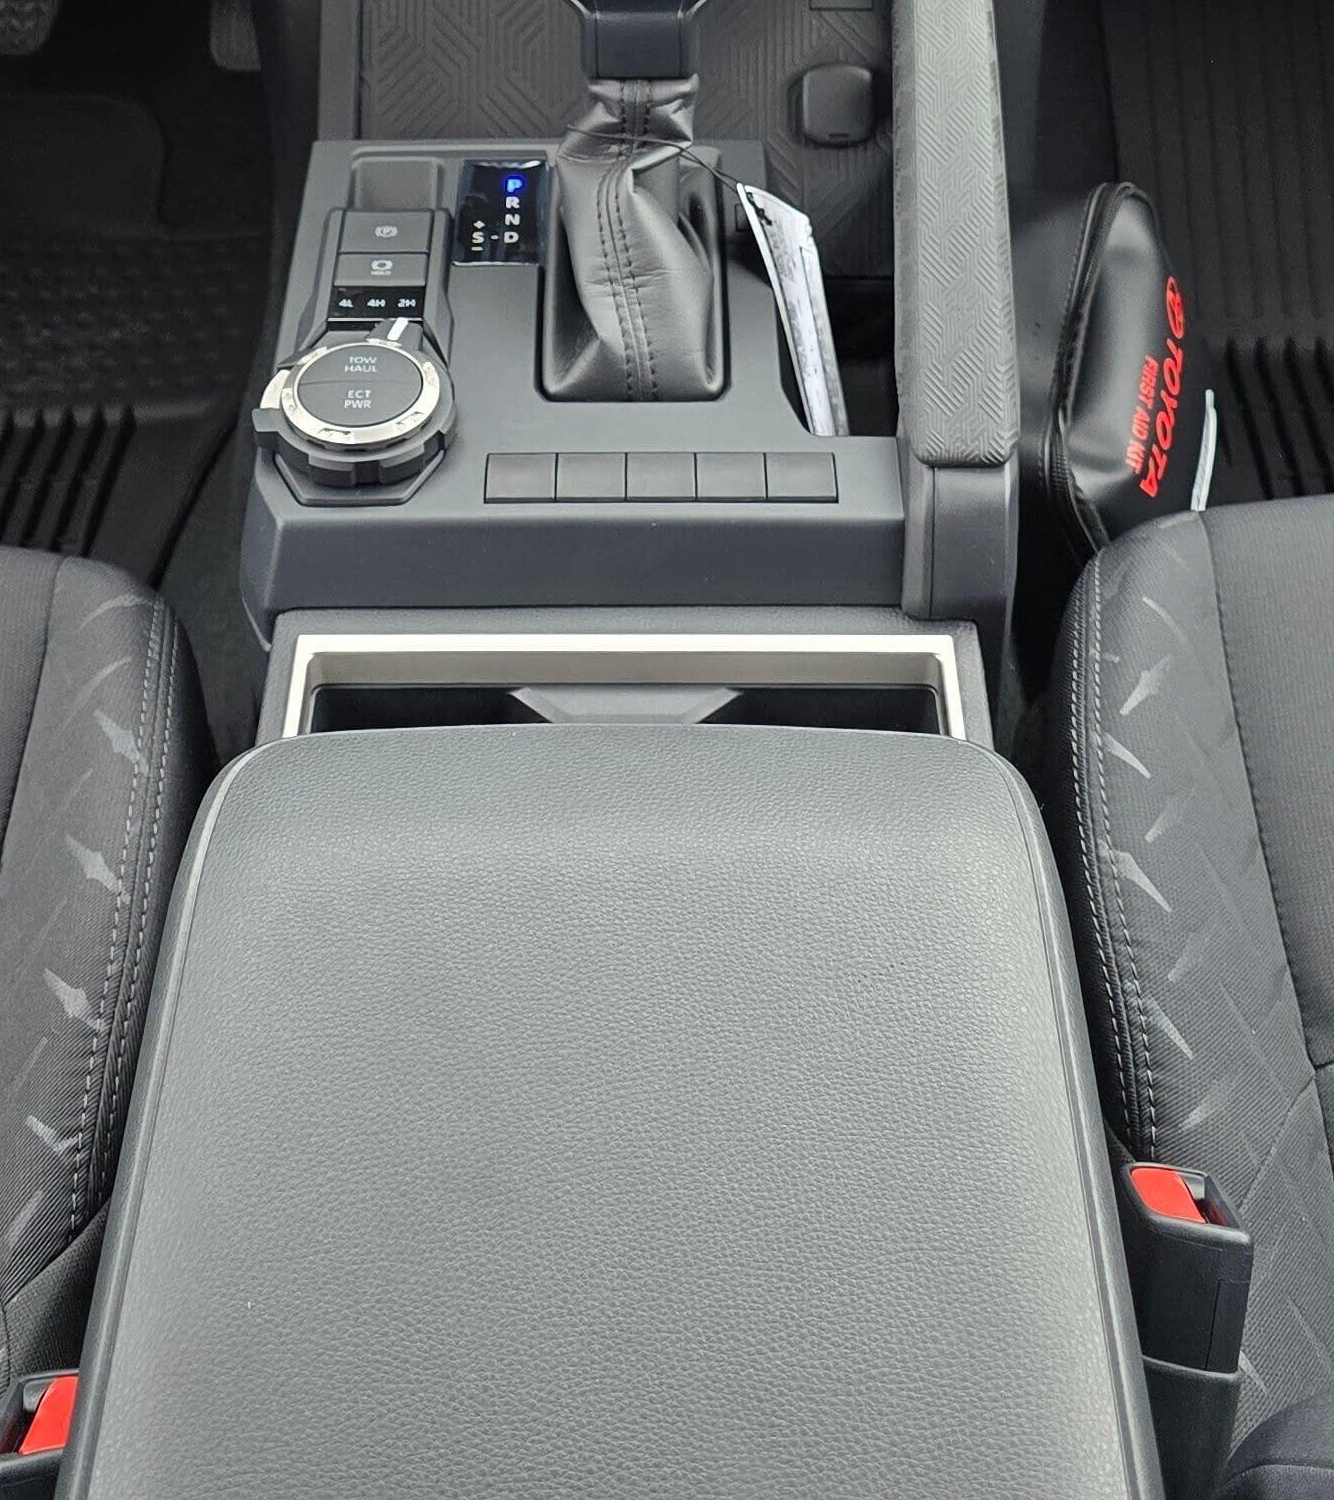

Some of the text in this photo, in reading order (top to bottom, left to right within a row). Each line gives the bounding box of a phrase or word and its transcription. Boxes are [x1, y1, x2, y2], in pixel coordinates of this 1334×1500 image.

[507, 178, 524, 193] P
[505, 196, 521, 209] R
[504, 213, 521, 226] N
[471, 231, 485, 244] S
[503, 231, 520, 244] D
[338, 298, 416, 308] 4L 4H 2H
[349, 356, 378, 365] TOW
[344, 364, 379, 373] HAUL
[347, 390, 372, 399] ECT
[344, 400, 372, 410] PWR
[1124, 355, 1159, 475] FIRST AID KIT
[1140, 338, 1184, 498] TOYOTA
